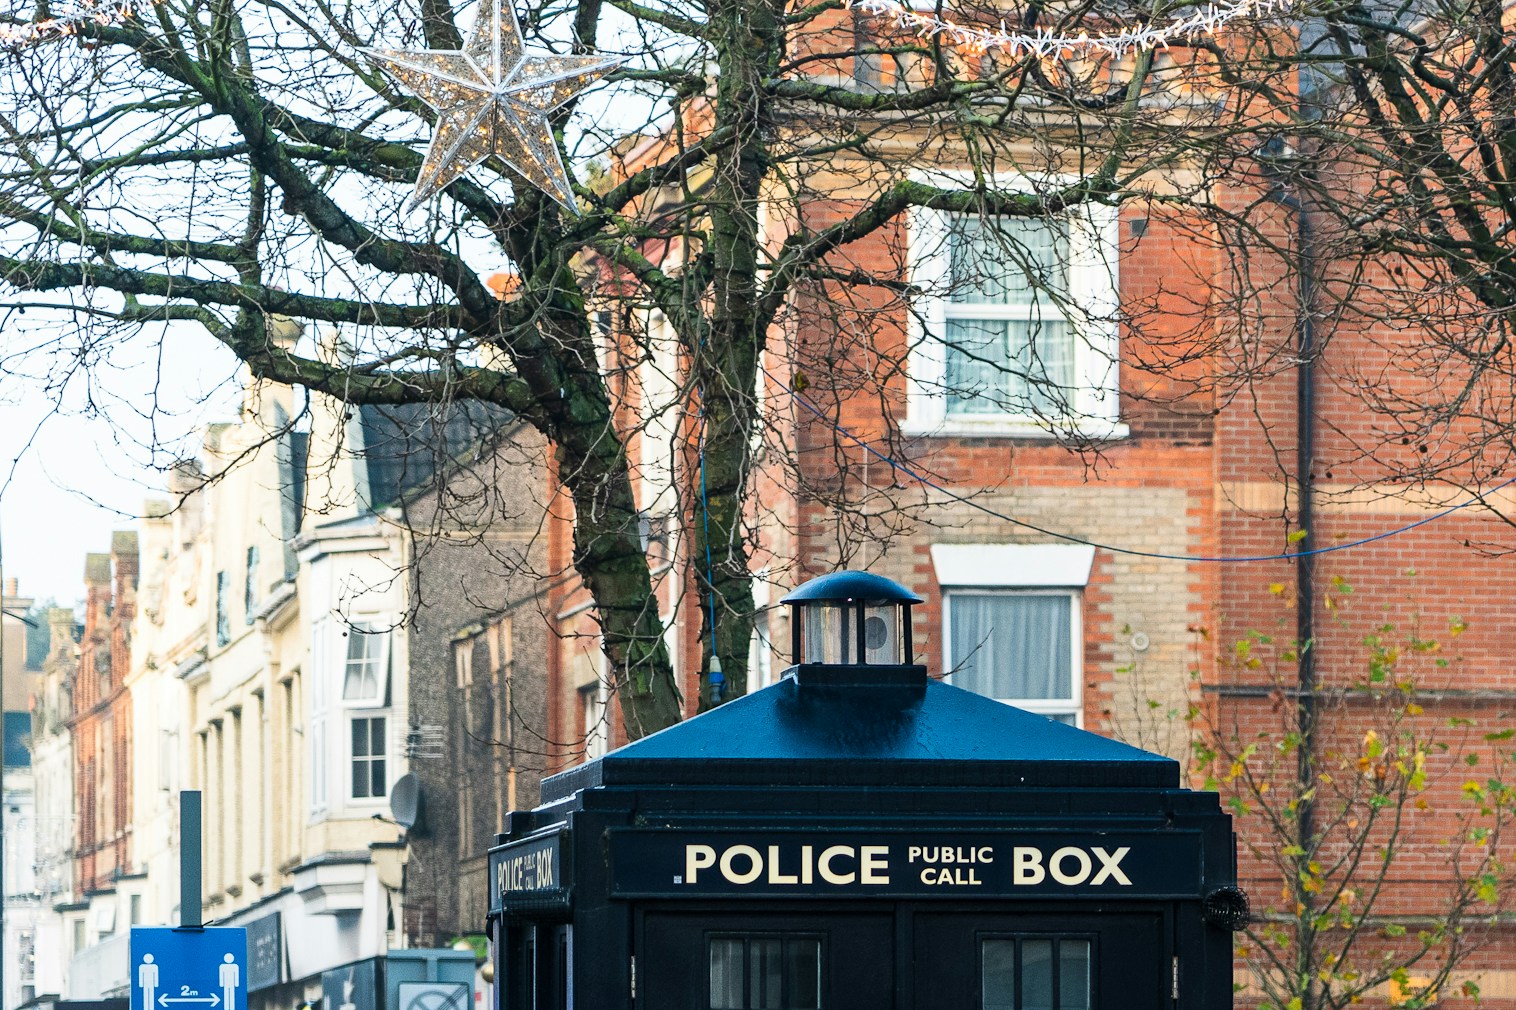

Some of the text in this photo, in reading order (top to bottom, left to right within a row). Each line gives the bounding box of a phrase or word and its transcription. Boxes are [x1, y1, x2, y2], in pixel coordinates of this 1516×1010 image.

[497, 857, 523, 899] POLICE
[536, 847, 553, 889] BOX
[686, 845, 1132, 885] POLICE PUBLIC CALL BOX
[181, 985, 199, 996] 2m
